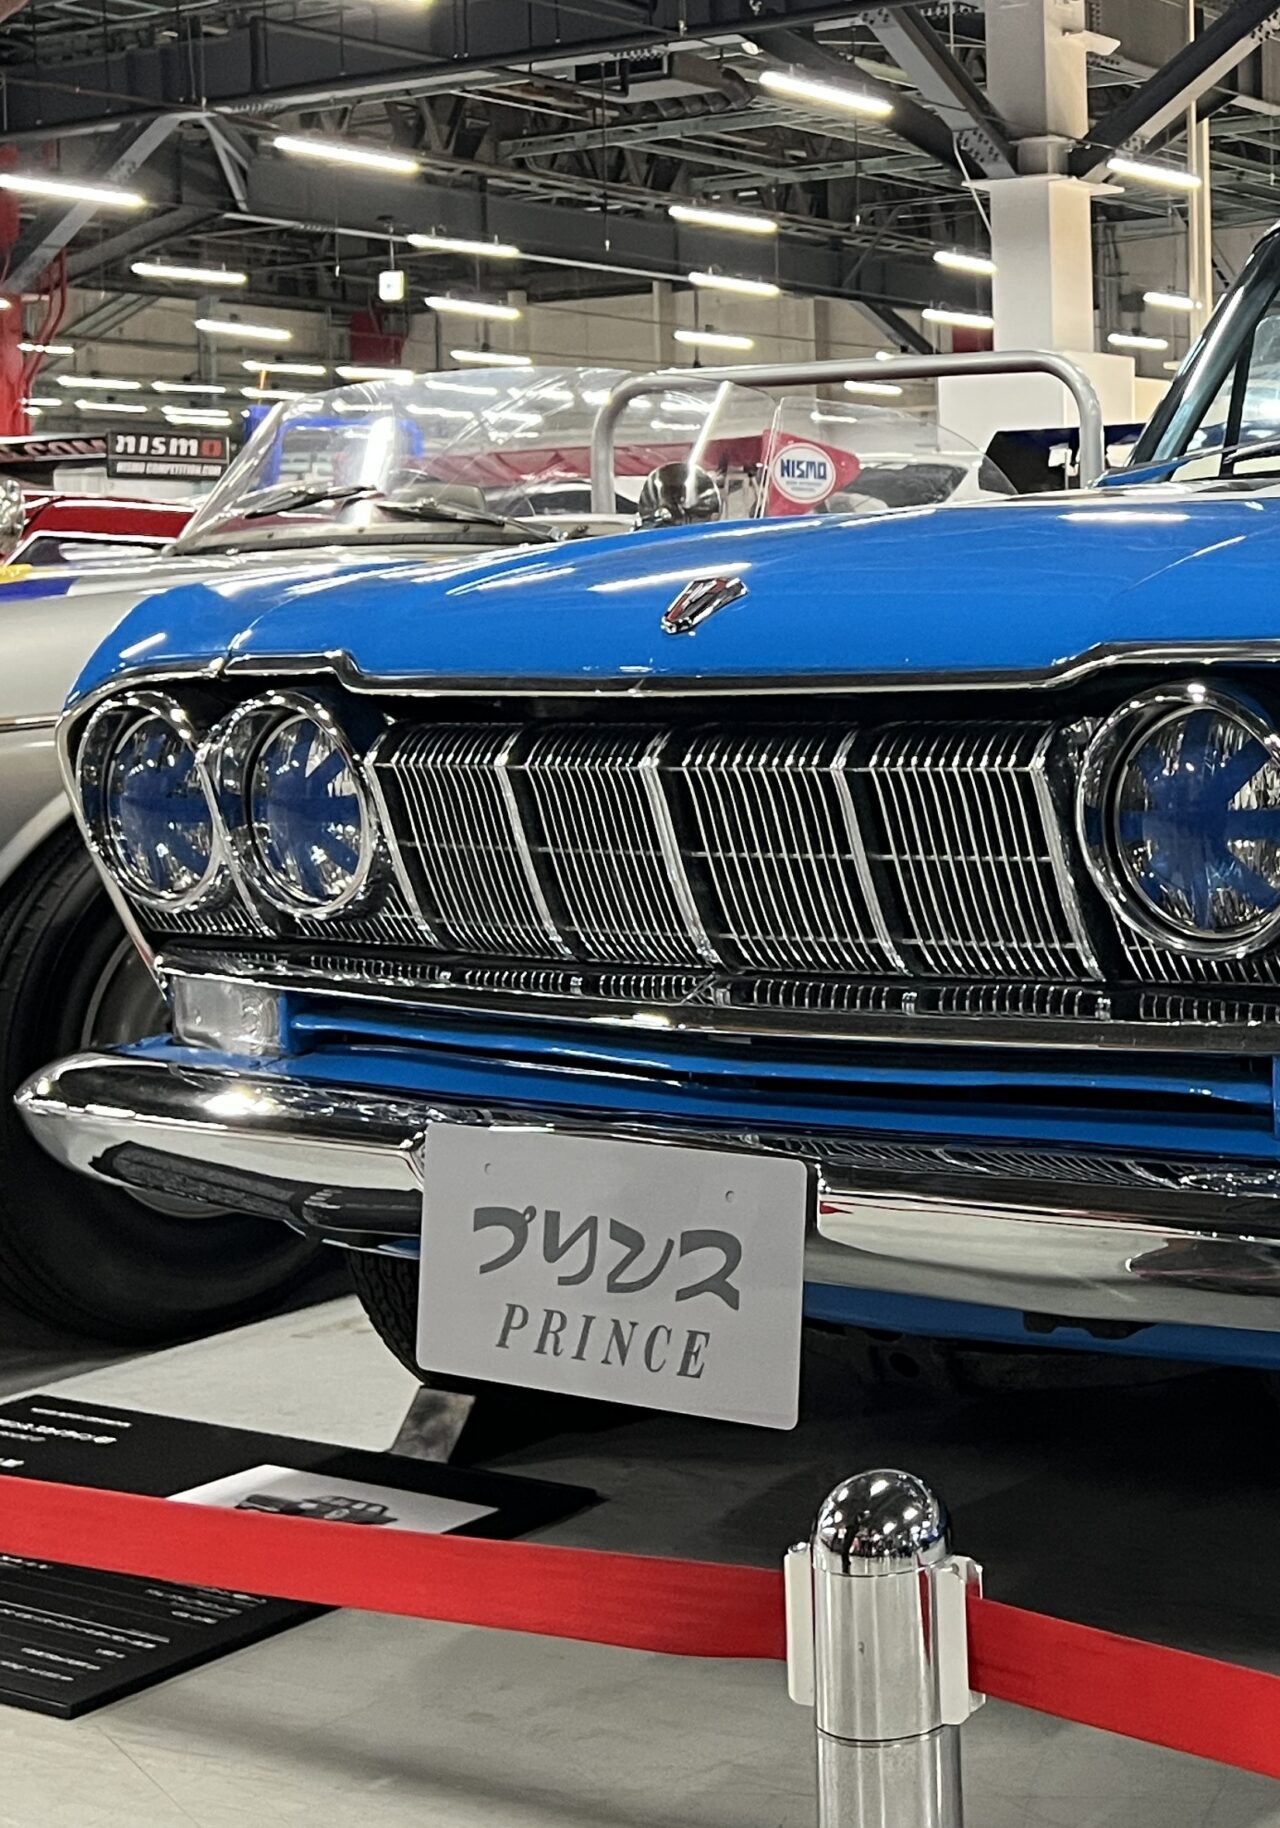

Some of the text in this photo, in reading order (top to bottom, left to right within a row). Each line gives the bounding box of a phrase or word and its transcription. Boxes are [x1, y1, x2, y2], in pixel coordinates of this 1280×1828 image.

[780, 458, 827, 480] NISMO
[472, 1205, 743, 1312] プリンス
[496, 1303, 711, 1379] PRINCE
